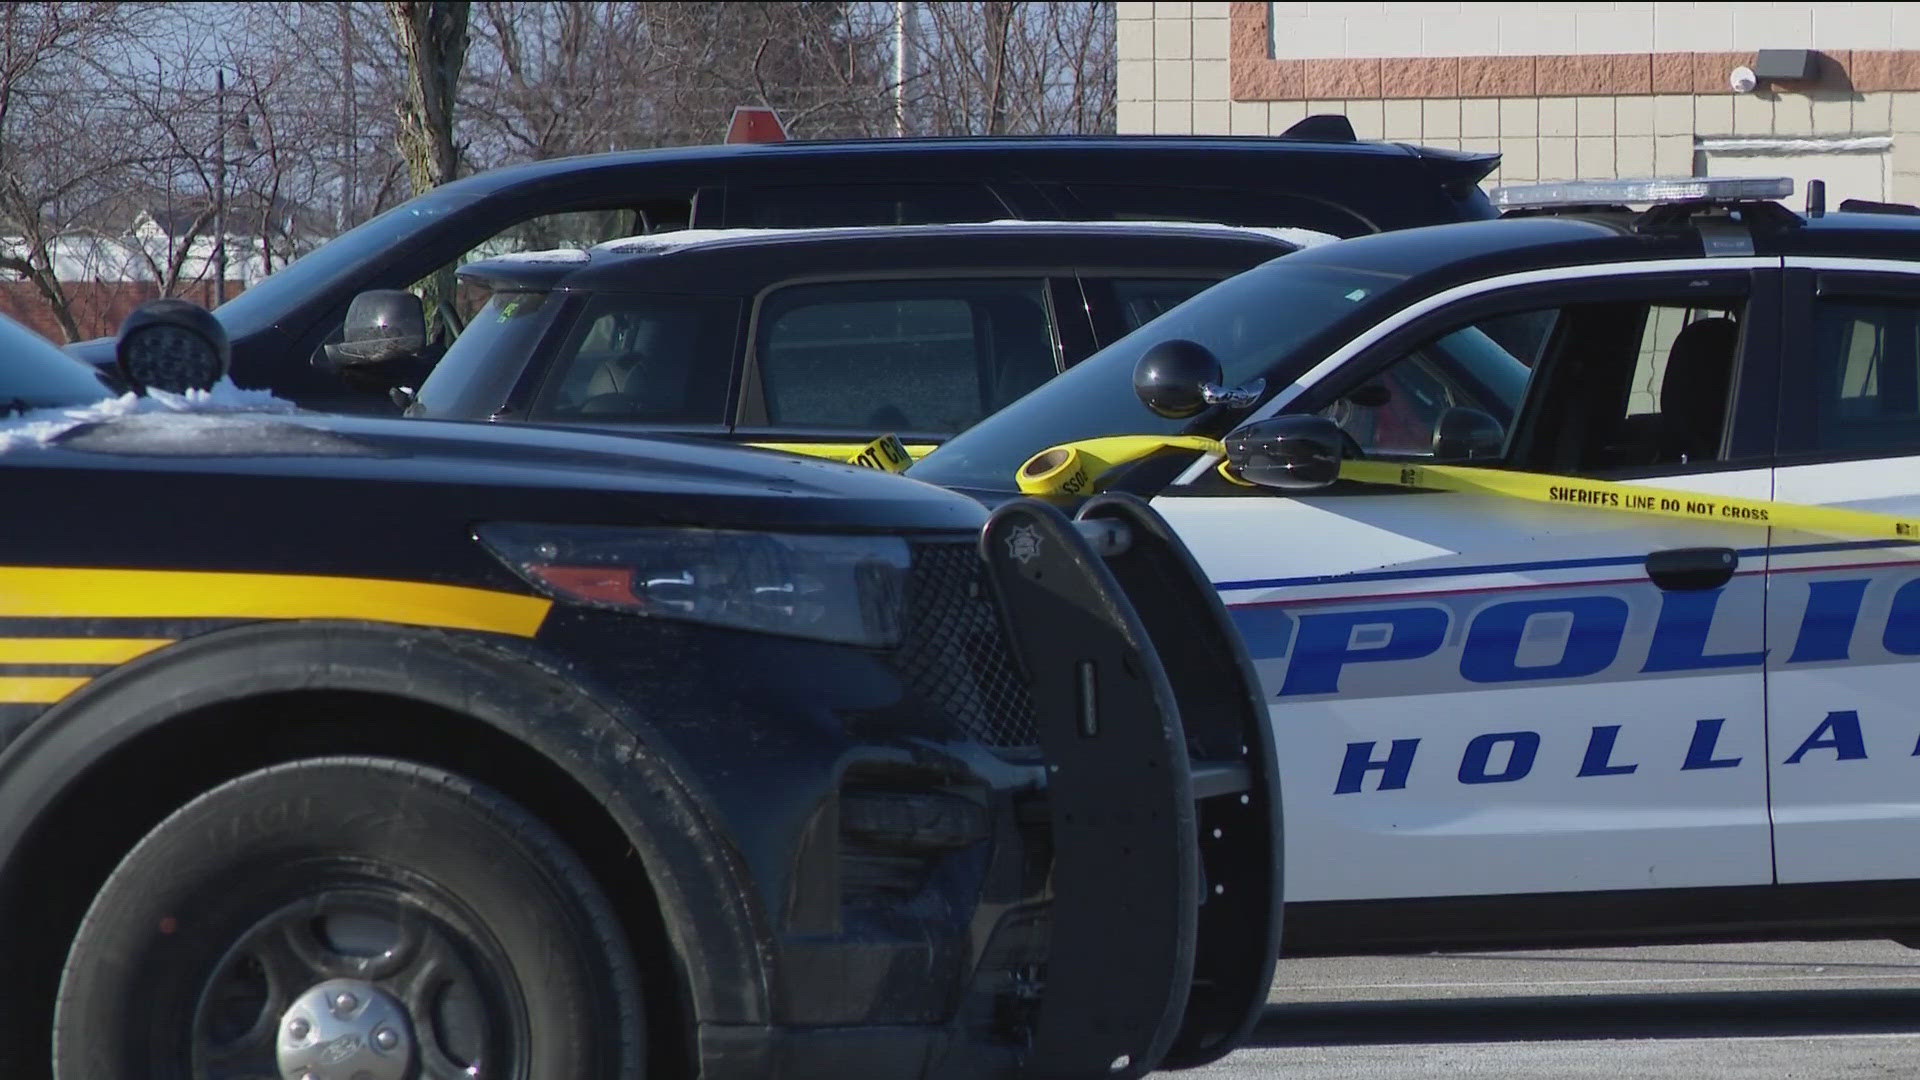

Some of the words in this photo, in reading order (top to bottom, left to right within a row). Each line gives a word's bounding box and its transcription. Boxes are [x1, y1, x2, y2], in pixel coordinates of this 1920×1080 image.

[1549, 486, 1619, 506] SHERIFFS
[1626, 494, 1656, 510] LINE
[1661, 498, 1681, 512] DO
[1687, 501, 1715, 515] NOT
[1722, 505, 1769, 521] CROSS
[1277, 577, 1920, 697] POLI
[1333, 709, 1920, 795] HOLLA
